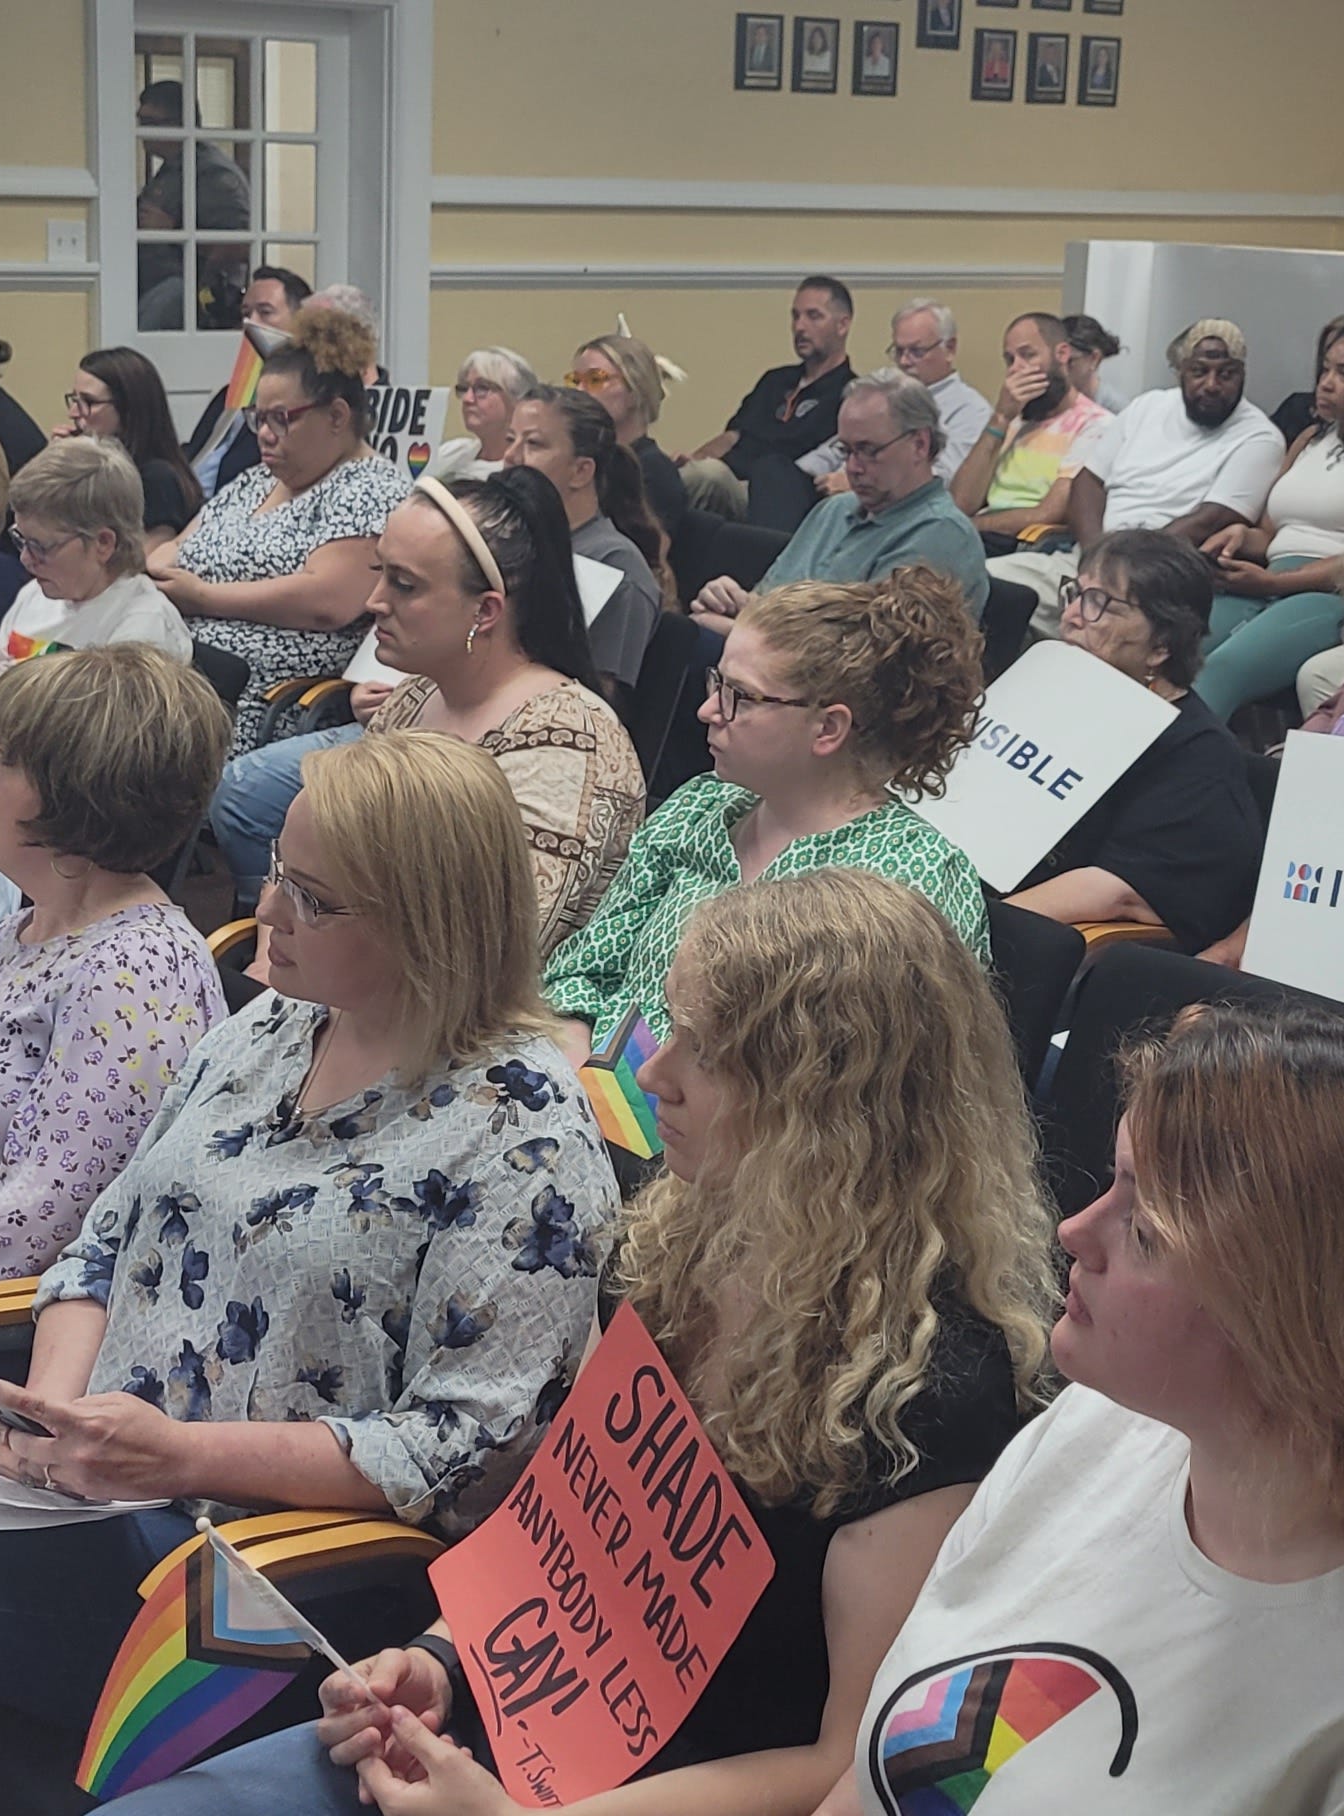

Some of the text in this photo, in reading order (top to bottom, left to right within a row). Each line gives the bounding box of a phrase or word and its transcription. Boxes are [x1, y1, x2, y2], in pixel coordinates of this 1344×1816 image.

[508, 1472, 659, 1758] ANYBODY LESS
[551, 1417, 709, 1693] NEVER MADE
[603, 1364, 751, 1609] SHADE
[483, 1596, 589, 1733] GAY!
